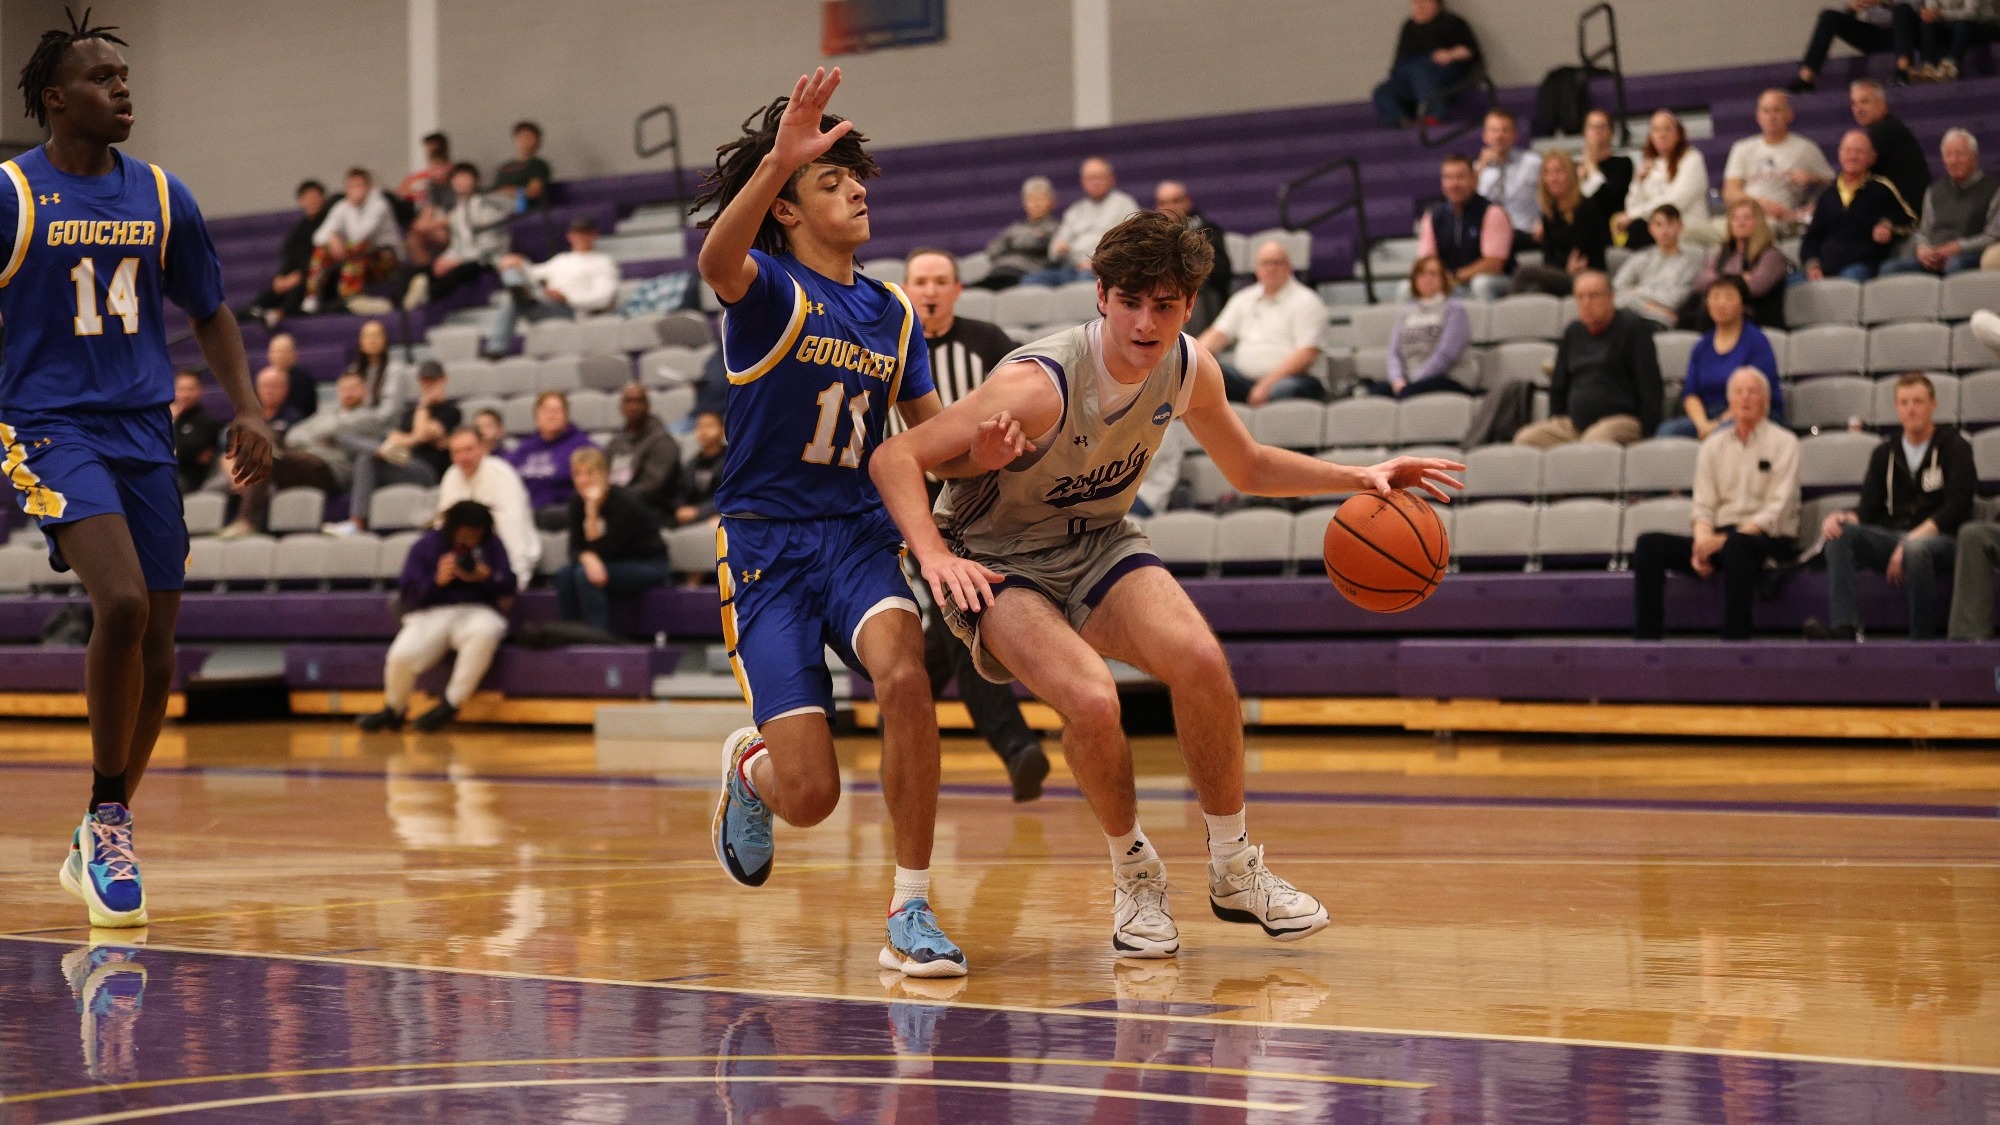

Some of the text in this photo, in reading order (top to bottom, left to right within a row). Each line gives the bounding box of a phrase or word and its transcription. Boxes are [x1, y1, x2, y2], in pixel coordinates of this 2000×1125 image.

[46, 220, 156, 247] GOUCHER
[70, 257, 141, 336] 14
[796, 335, 897, 382] GOUCHER
[801, 381, 871, 468] 11
